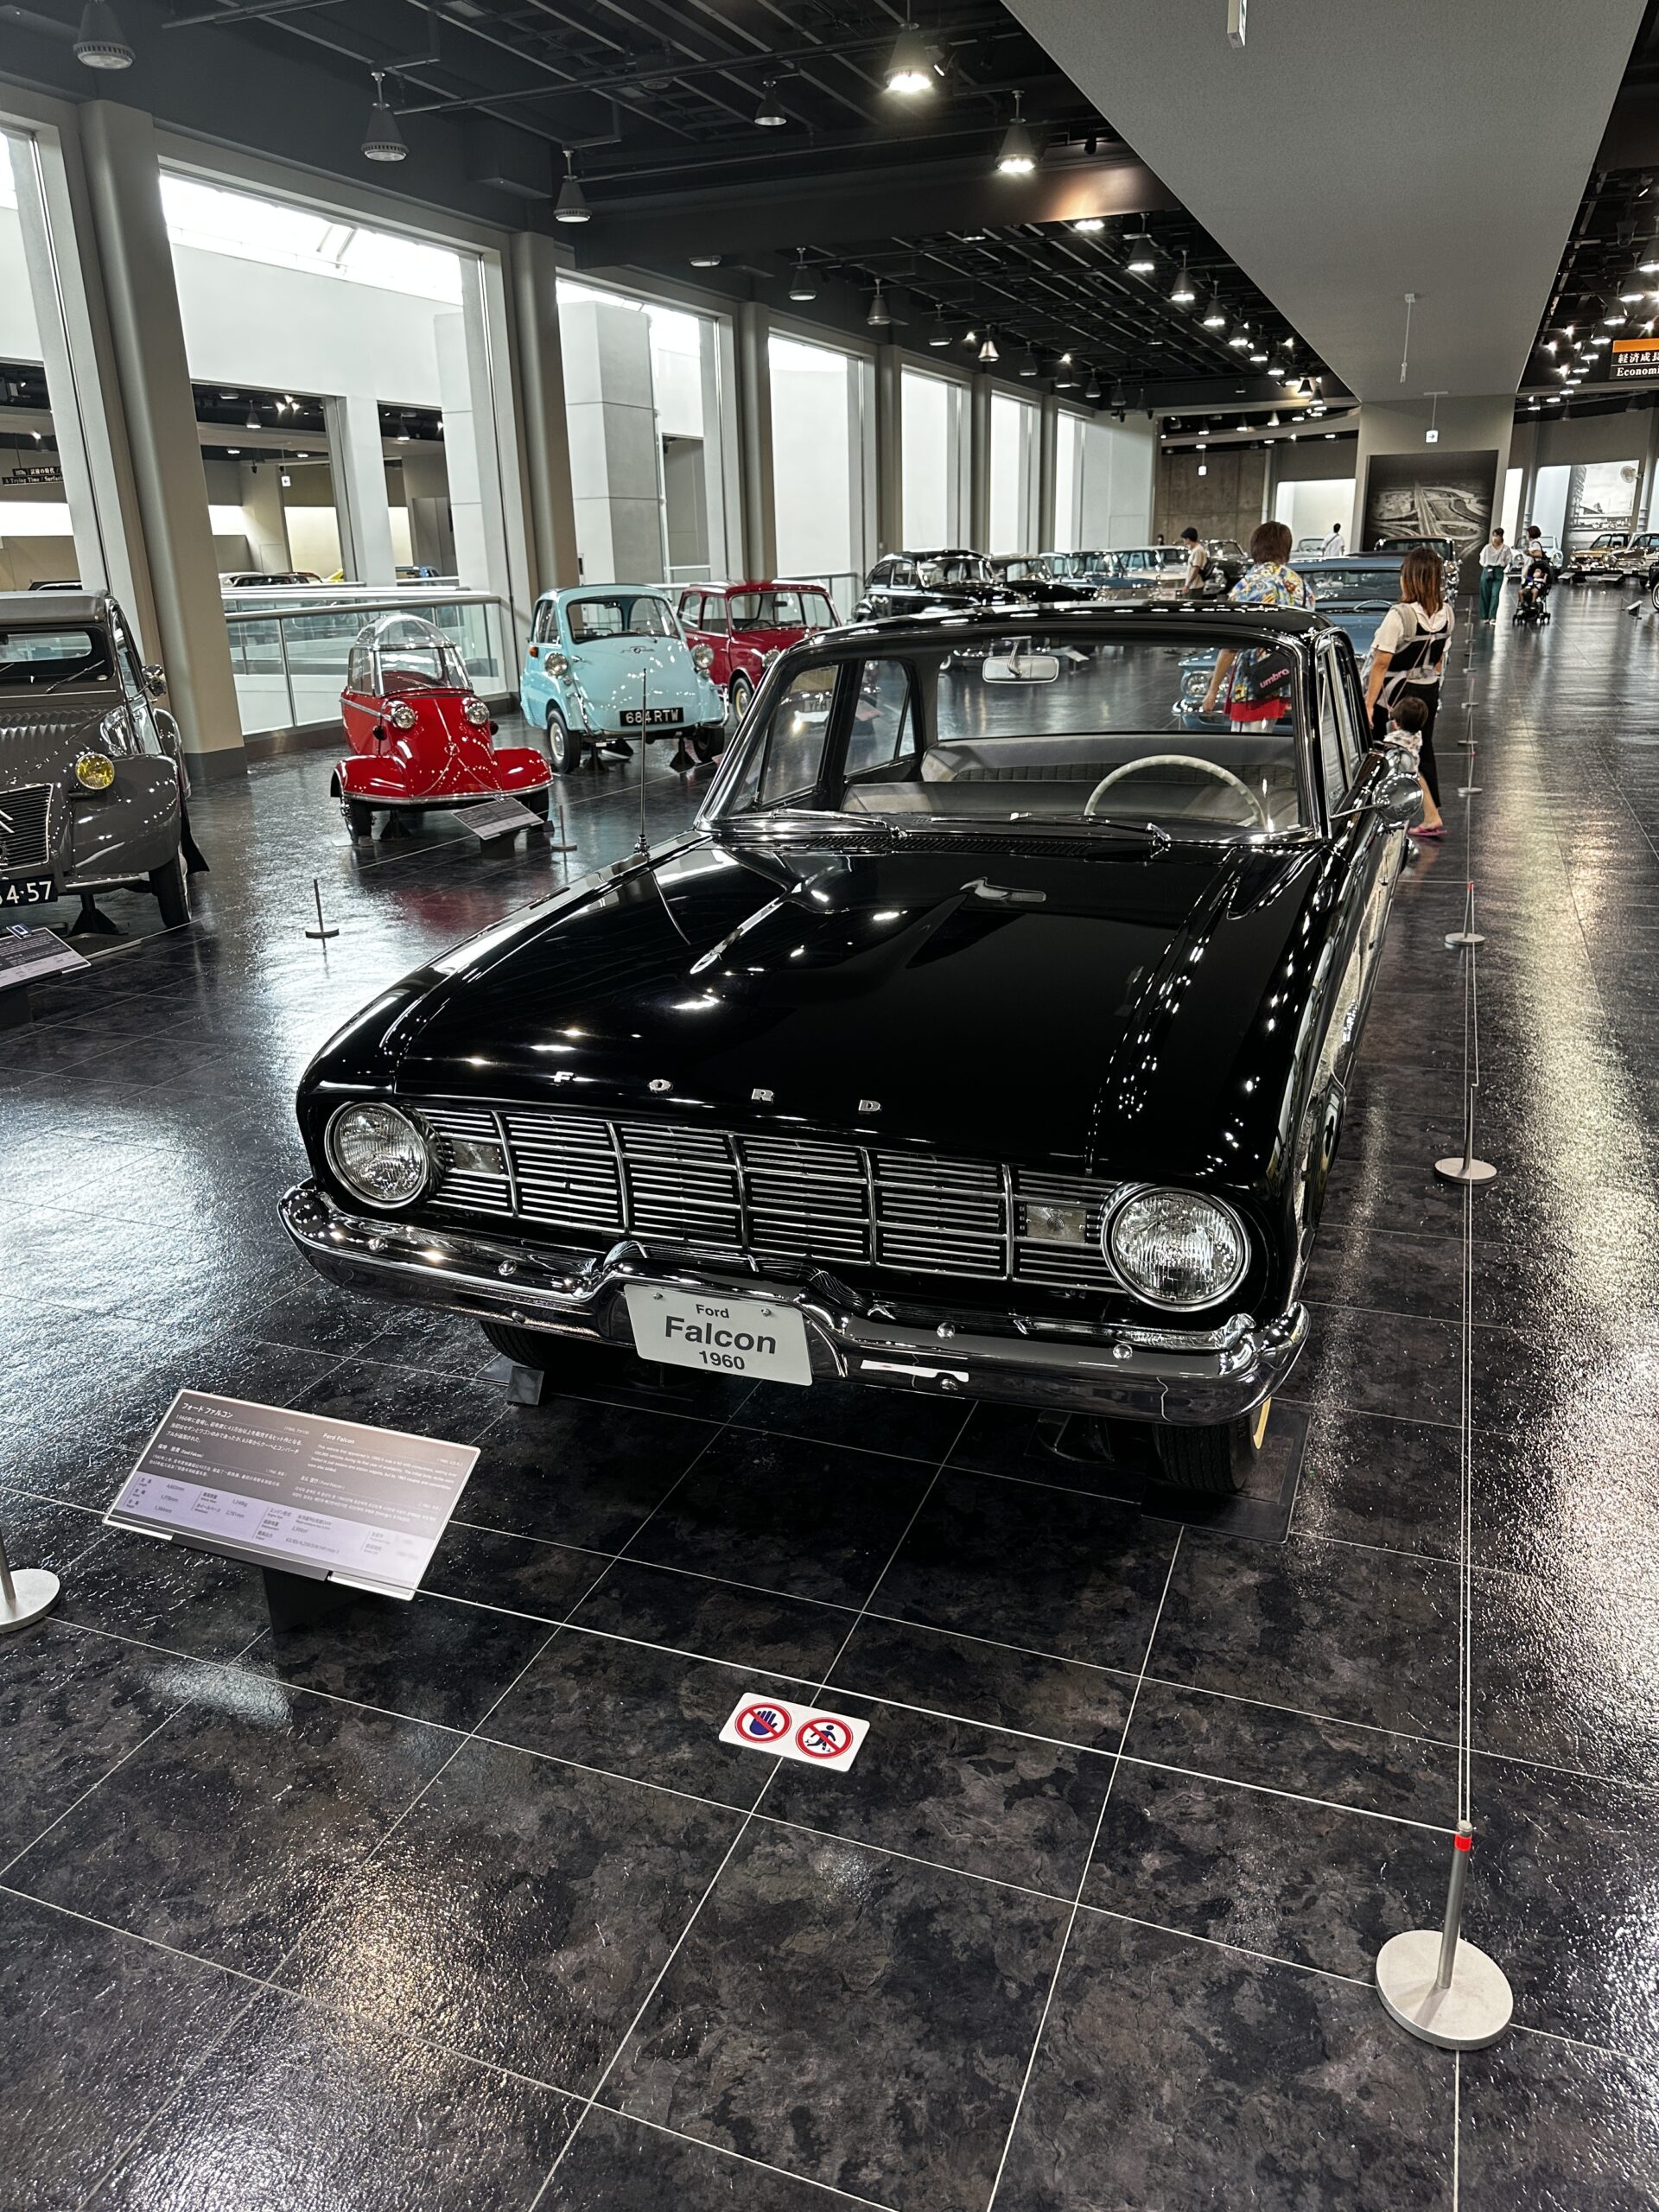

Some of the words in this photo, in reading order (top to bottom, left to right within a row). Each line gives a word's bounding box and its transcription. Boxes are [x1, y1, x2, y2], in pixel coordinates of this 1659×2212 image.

[1260, 669, 1290, 689] umbro
[654, 709, 679, 722] RTW
[554, 1071, 882, 1115] FORD
[696, 1303, 730, 1319] Ford
[664, 1315, 777, 1354] Falcon
[699, 1350, 745, 1370] 1960
[181, 1402, 205, 1413] フォード
[203, 1407, 234, 1419] ファルコン
[336, 1435, 355, 1444] Falcon
